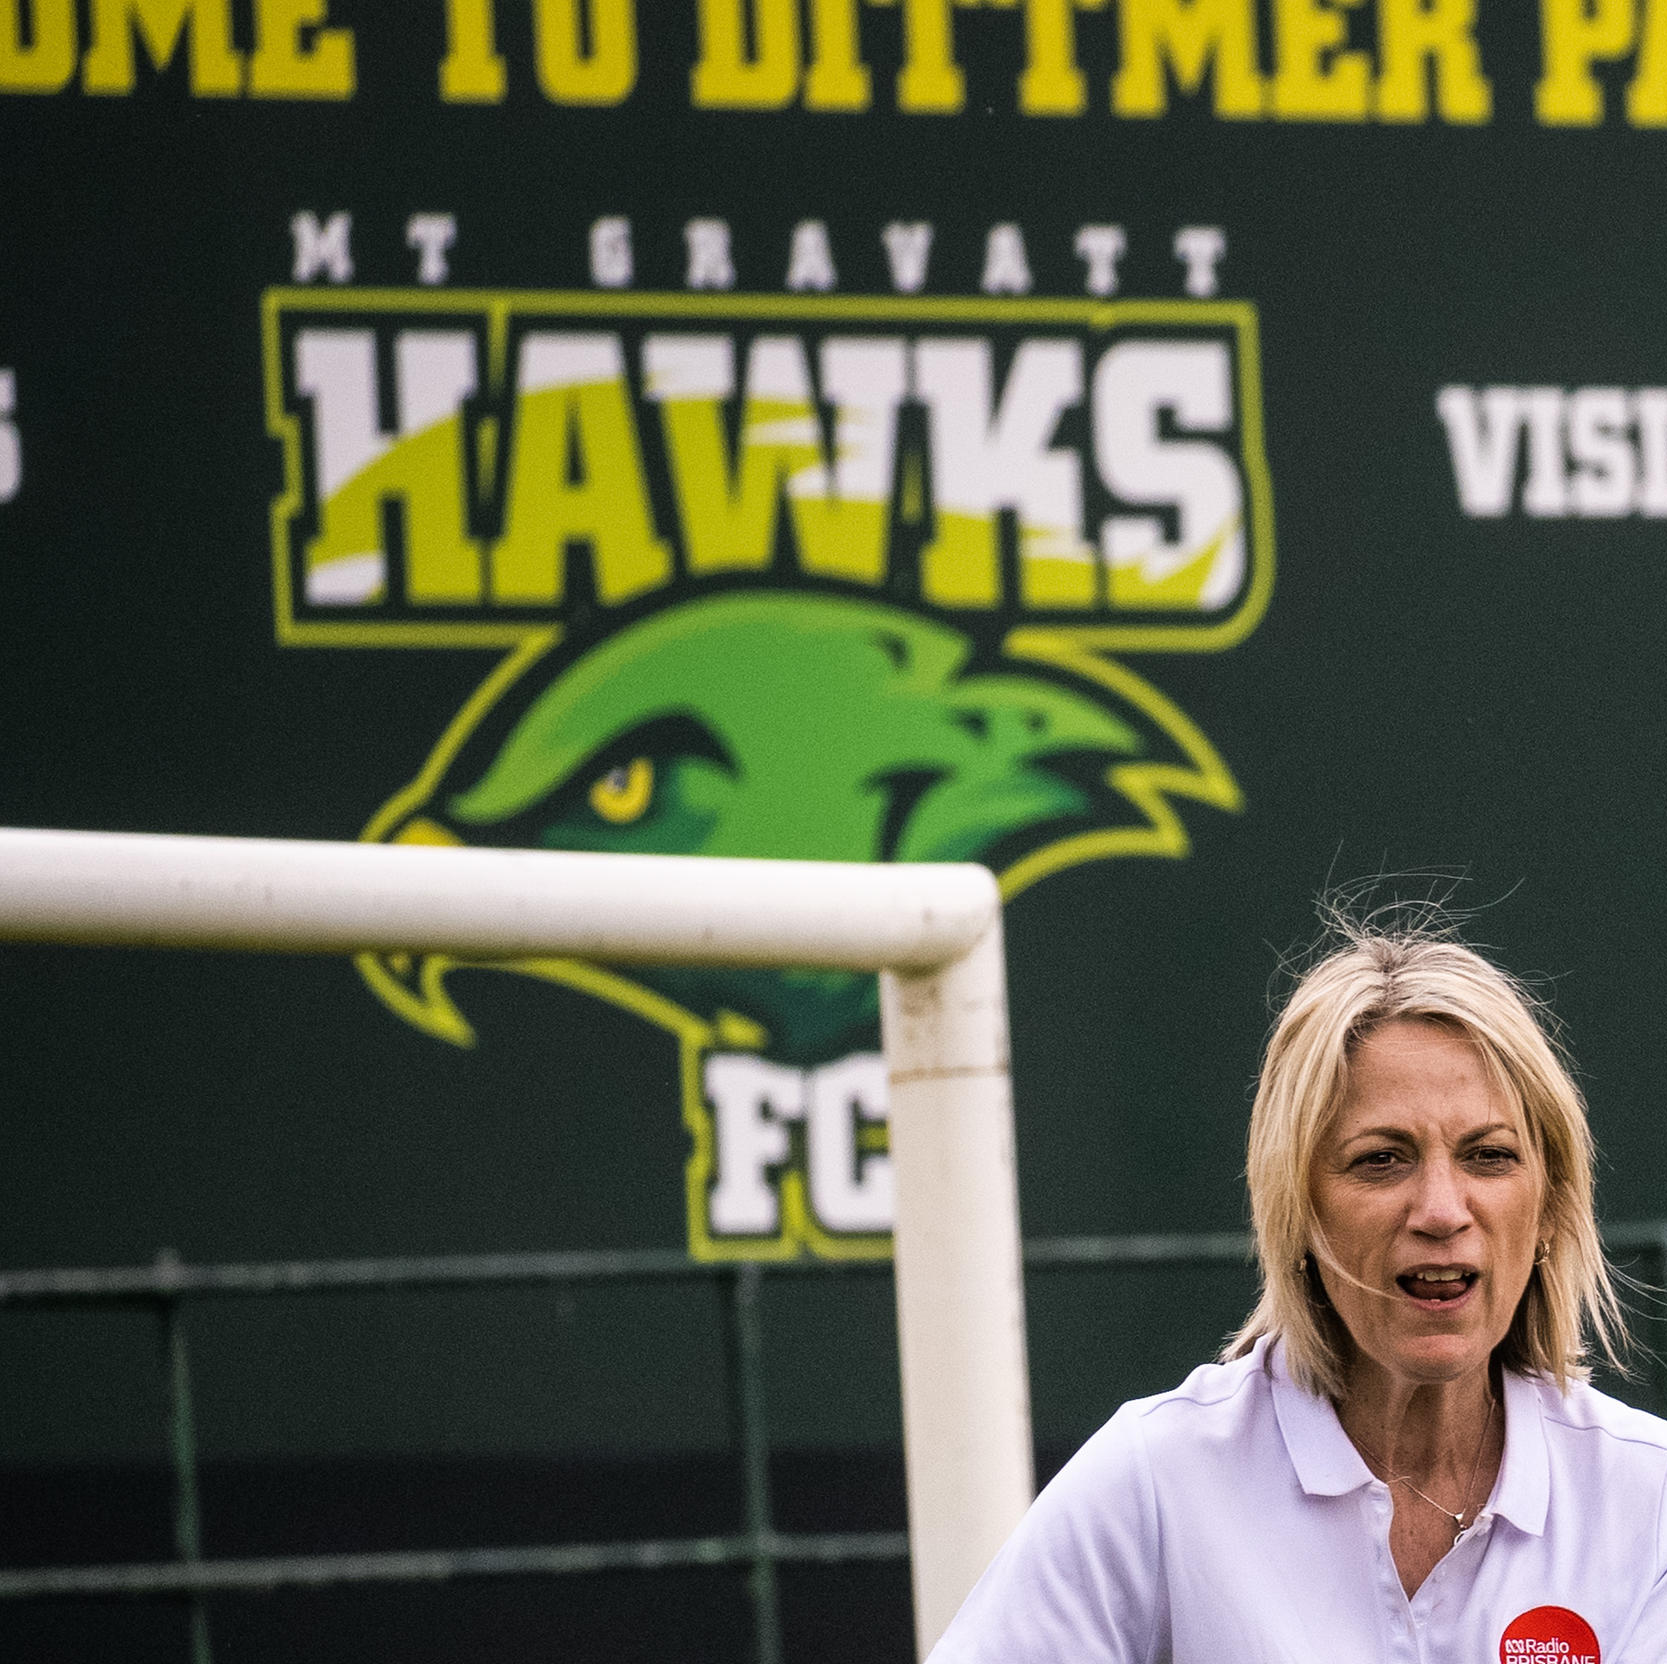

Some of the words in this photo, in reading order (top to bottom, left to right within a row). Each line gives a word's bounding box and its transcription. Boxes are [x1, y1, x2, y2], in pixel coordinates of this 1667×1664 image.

[690, 0, 1493, 122] DITTMER
[290, 209, 457, 287] MT
[588, 215, 1227, 298] GRAVATT
[294, 328, 1245, 610] HAWKS
[705, 1052, 894, 1234] FC
[1525, 1637, 1570, 1654] Radio
